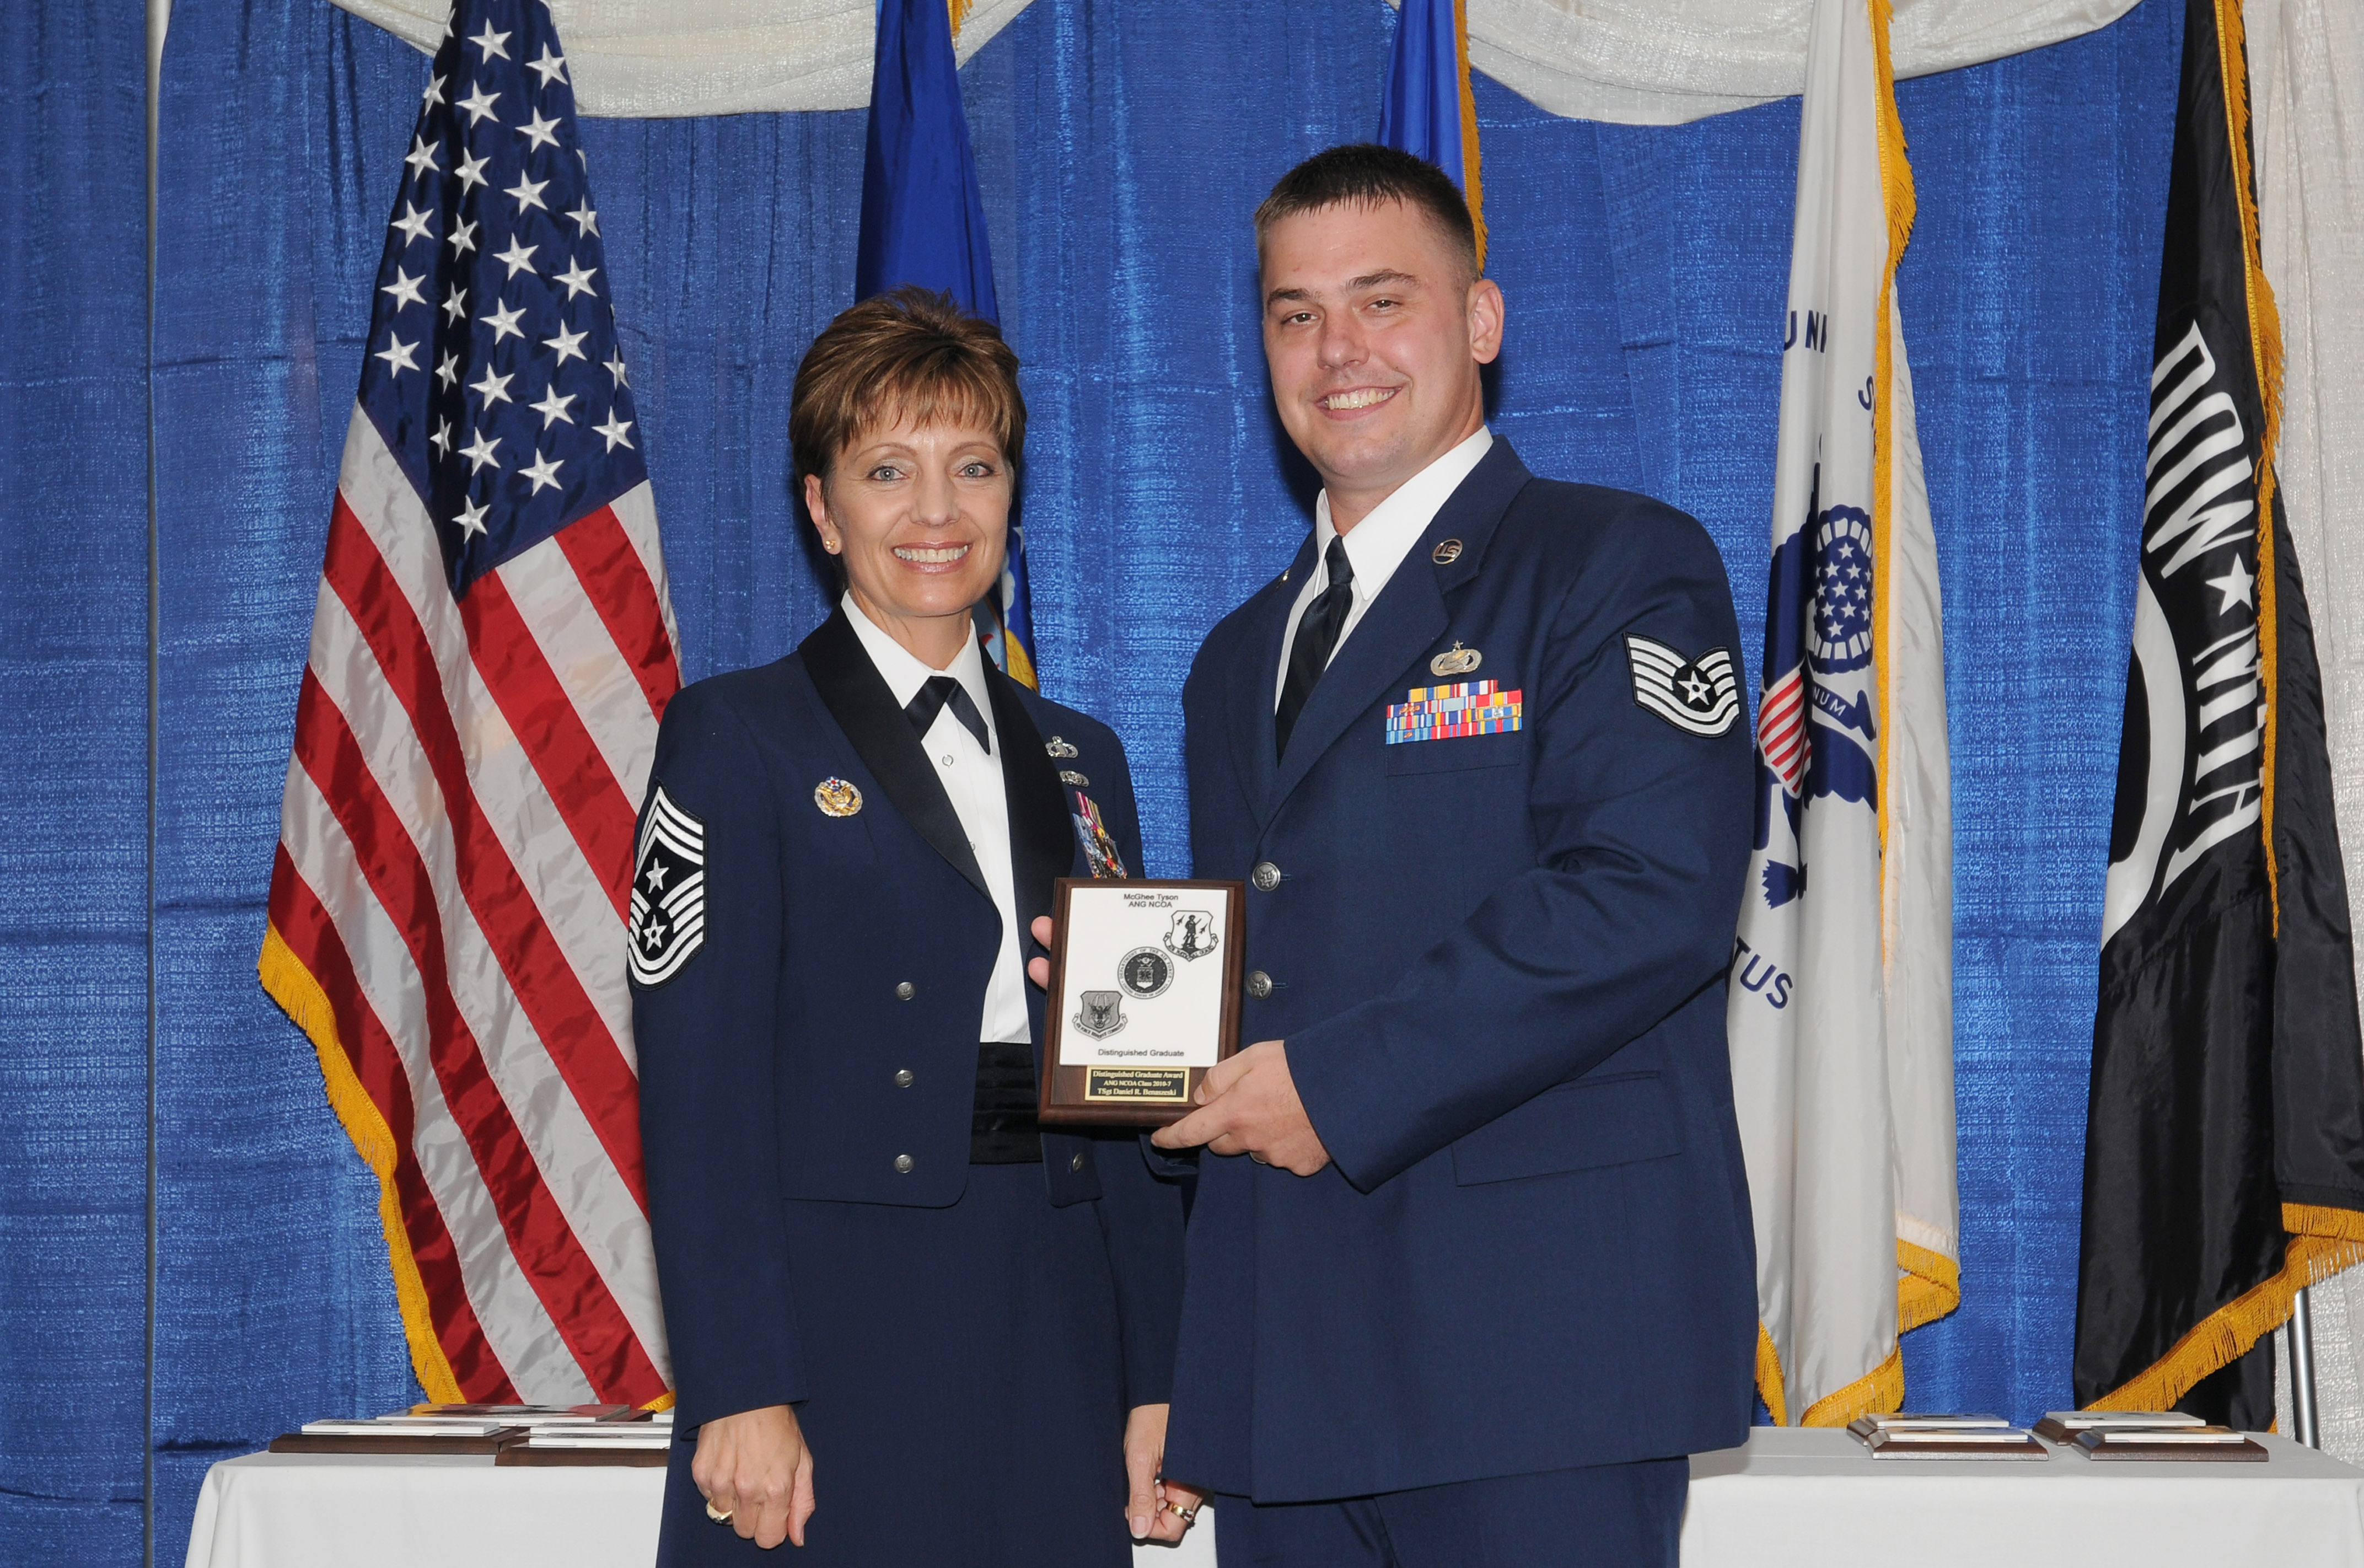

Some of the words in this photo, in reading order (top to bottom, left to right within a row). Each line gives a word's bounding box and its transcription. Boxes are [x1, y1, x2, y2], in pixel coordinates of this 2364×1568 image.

[2143, 318, 2255, 579] POW
[1098, 1049, 1148, 1057] Distinguished
[1093, 1071, 1134, 1079] Distinguished
